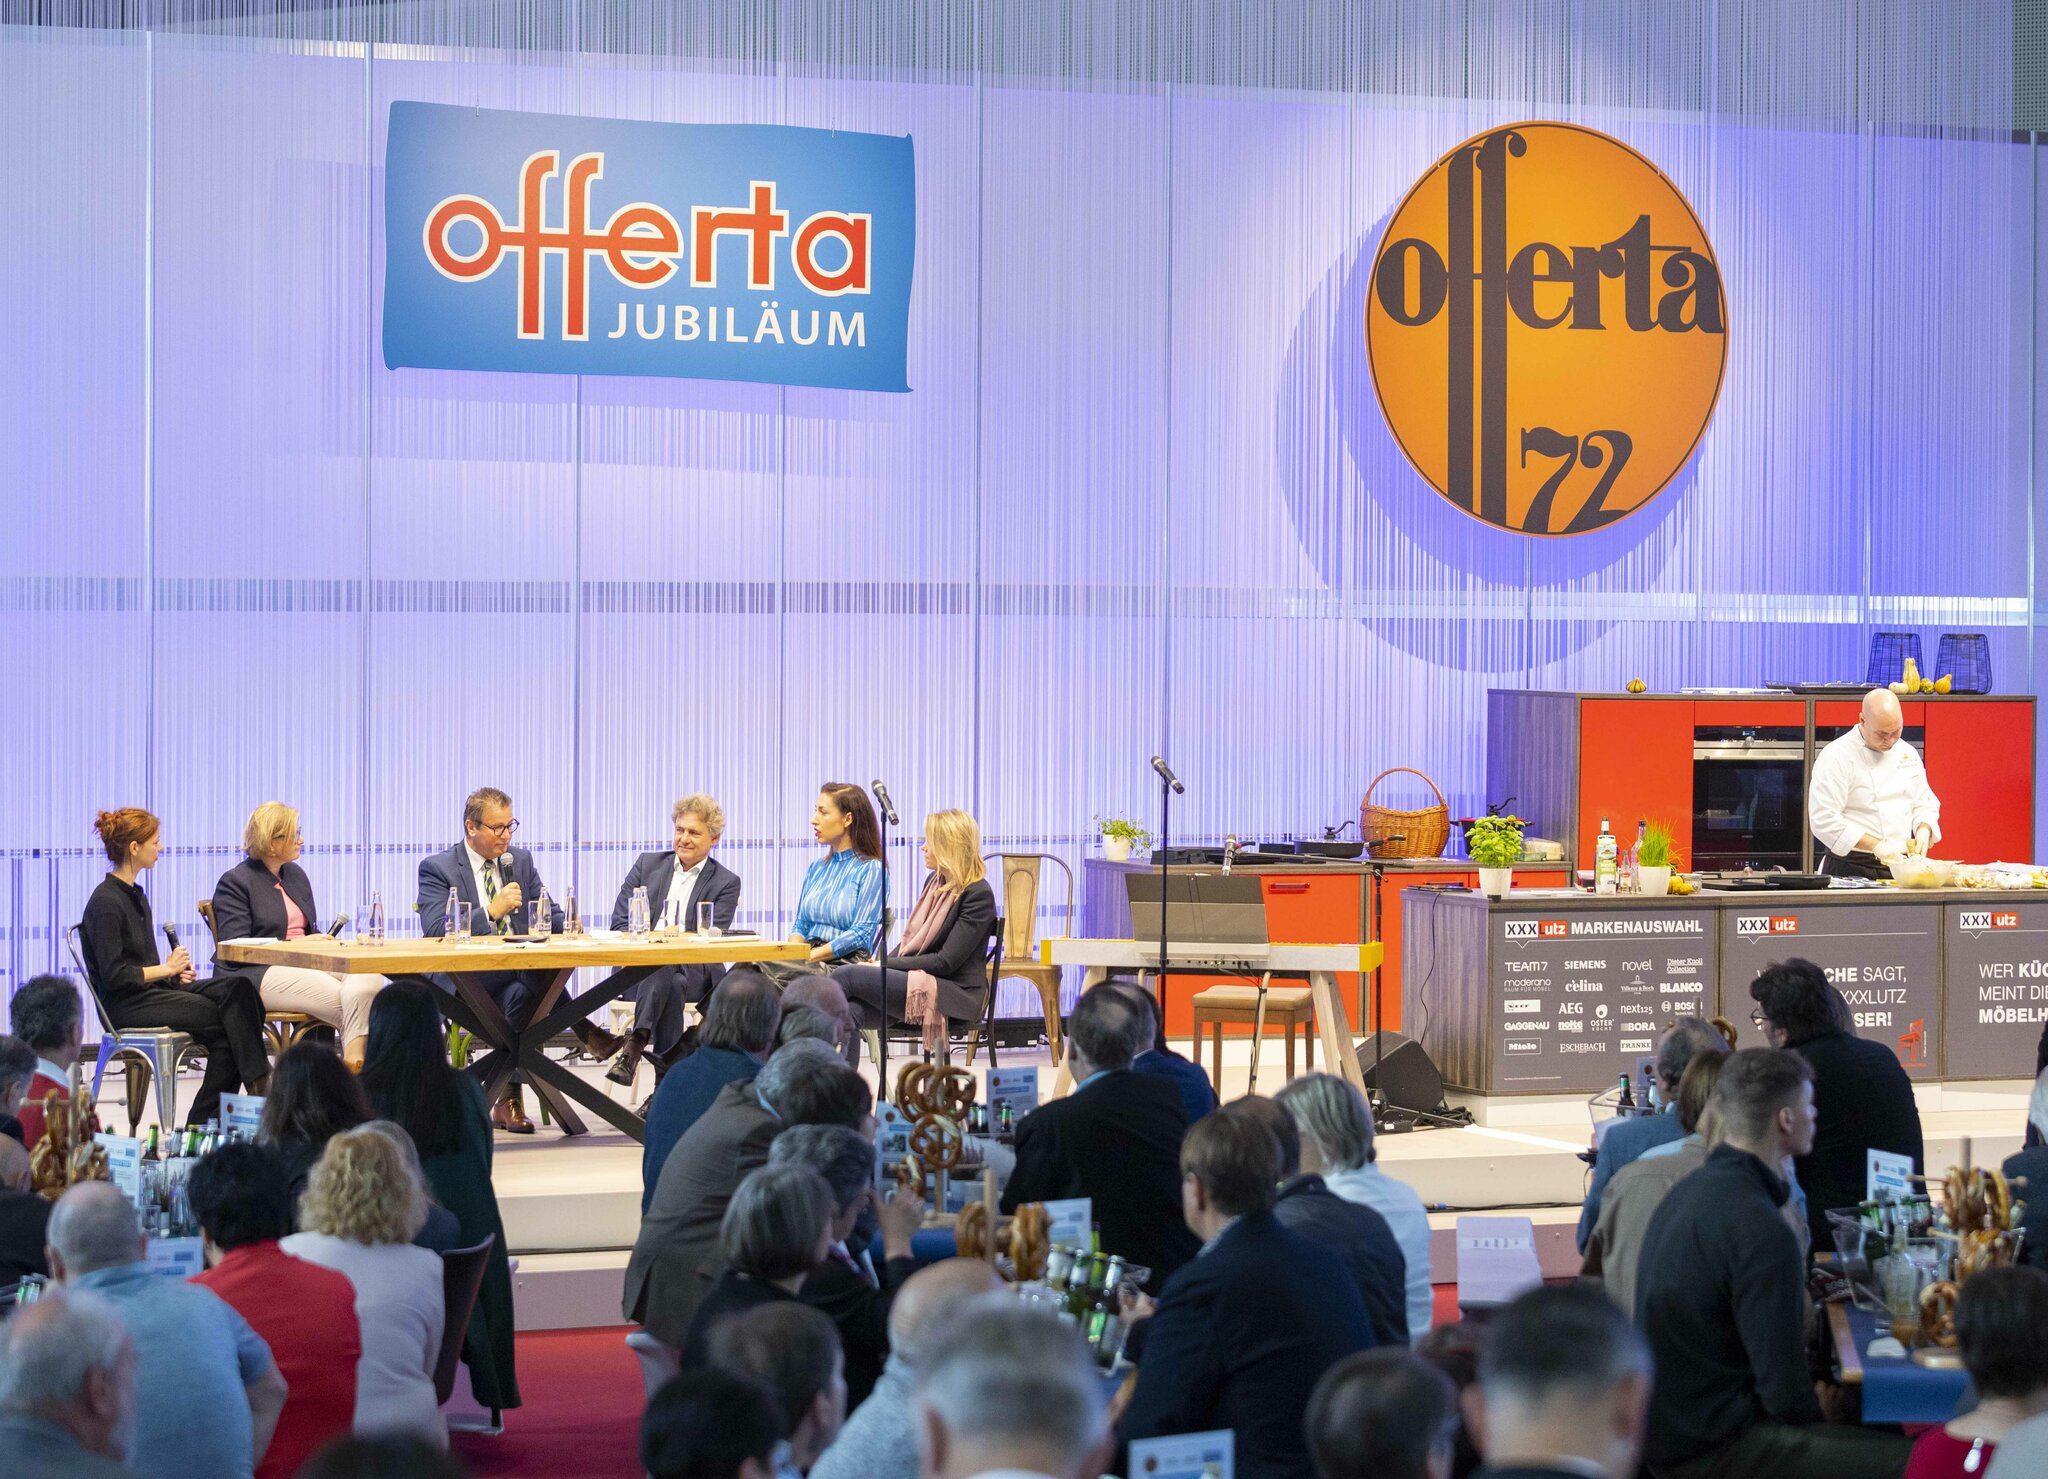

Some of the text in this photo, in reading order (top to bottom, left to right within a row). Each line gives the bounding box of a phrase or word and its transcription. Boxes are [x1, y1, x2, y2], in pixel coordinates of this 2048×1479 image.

[423, 149, 871, 341] offerta
[607, 300, 866, 347] JUBILÄUM
[1376, 130, 1726, 526] offerta
[1520, 425, 1634, 534] 72
[1571, 920, 1704, 935] MARKENAUSWAHL
[1564, 960, 1607, 970] SIEMENS
[1622, 959, 1653, 971] novel
[1979, 963, 2014, 978] WER
[1862, 966, 1907, 983] SAGT,
[1503, 979, 1552, 987] moderano
[1659, 982, 1704, 993] BLANCO
[1979, 985, 2026, 1001] MEINT
[1558, 1002, 1584, 1014] AEG
[1504, 1021, 1551, 1031] GAGGENAU
[1628, 1022, 1657, 1032] BORA
[1508, 1042, 1537, 1051] Miele
[1560, 1042, 1606, 1053] ESCHEBACH
[1621, 1041, 1651, 1049] FRANKE
